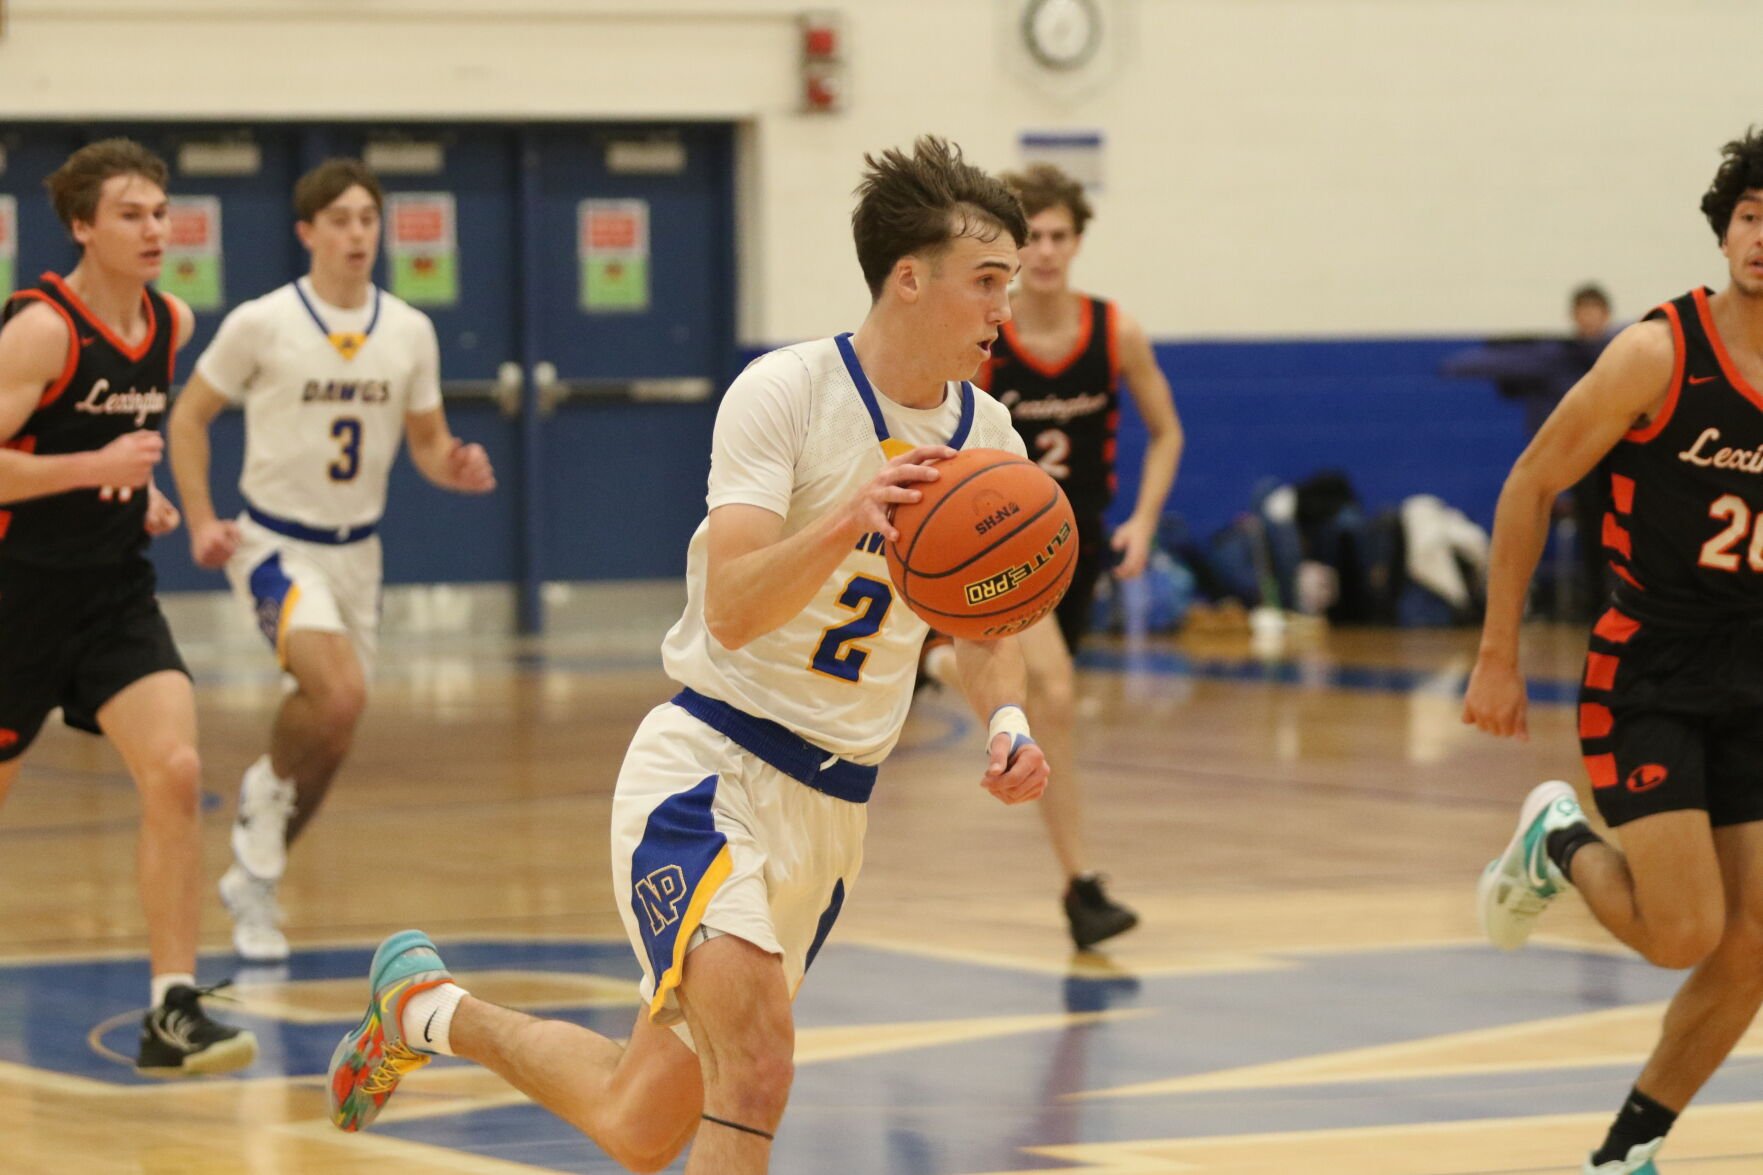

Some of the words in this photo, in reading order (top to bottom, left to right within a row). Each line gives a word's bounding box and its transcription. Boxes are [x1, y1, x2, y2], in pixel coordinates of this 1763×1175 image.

[327, 415, 366, 484] 3
[1035, 428, 1071, 479] 2
[975, 504, 1011, 535] NFHS
[1009, 520, 1071, 585] ELITE
[967, 573, 1011, 604] PRO
[808, 572, 896, 686] 2
[635, 864, 687, 936] NP
